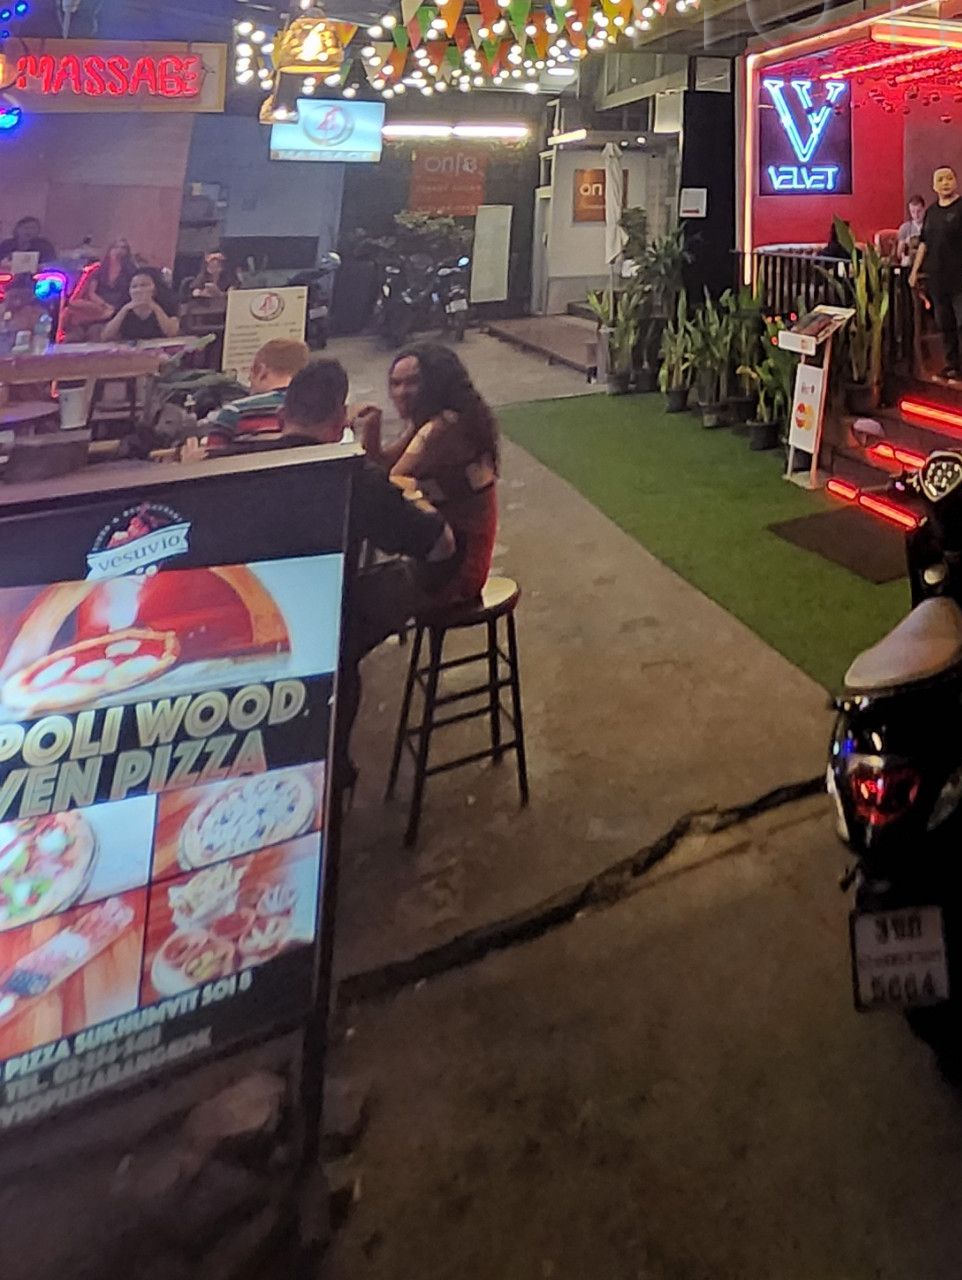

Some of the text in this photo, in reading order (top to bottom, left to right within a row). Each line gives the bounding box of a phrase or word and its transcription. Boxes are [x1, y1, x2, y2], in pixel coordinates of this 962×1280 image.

[15, 55, 200, 97] MASSAGE
[767, 165, 839, 191] VELVET
[109, 730, 268, 801] PIZZA
